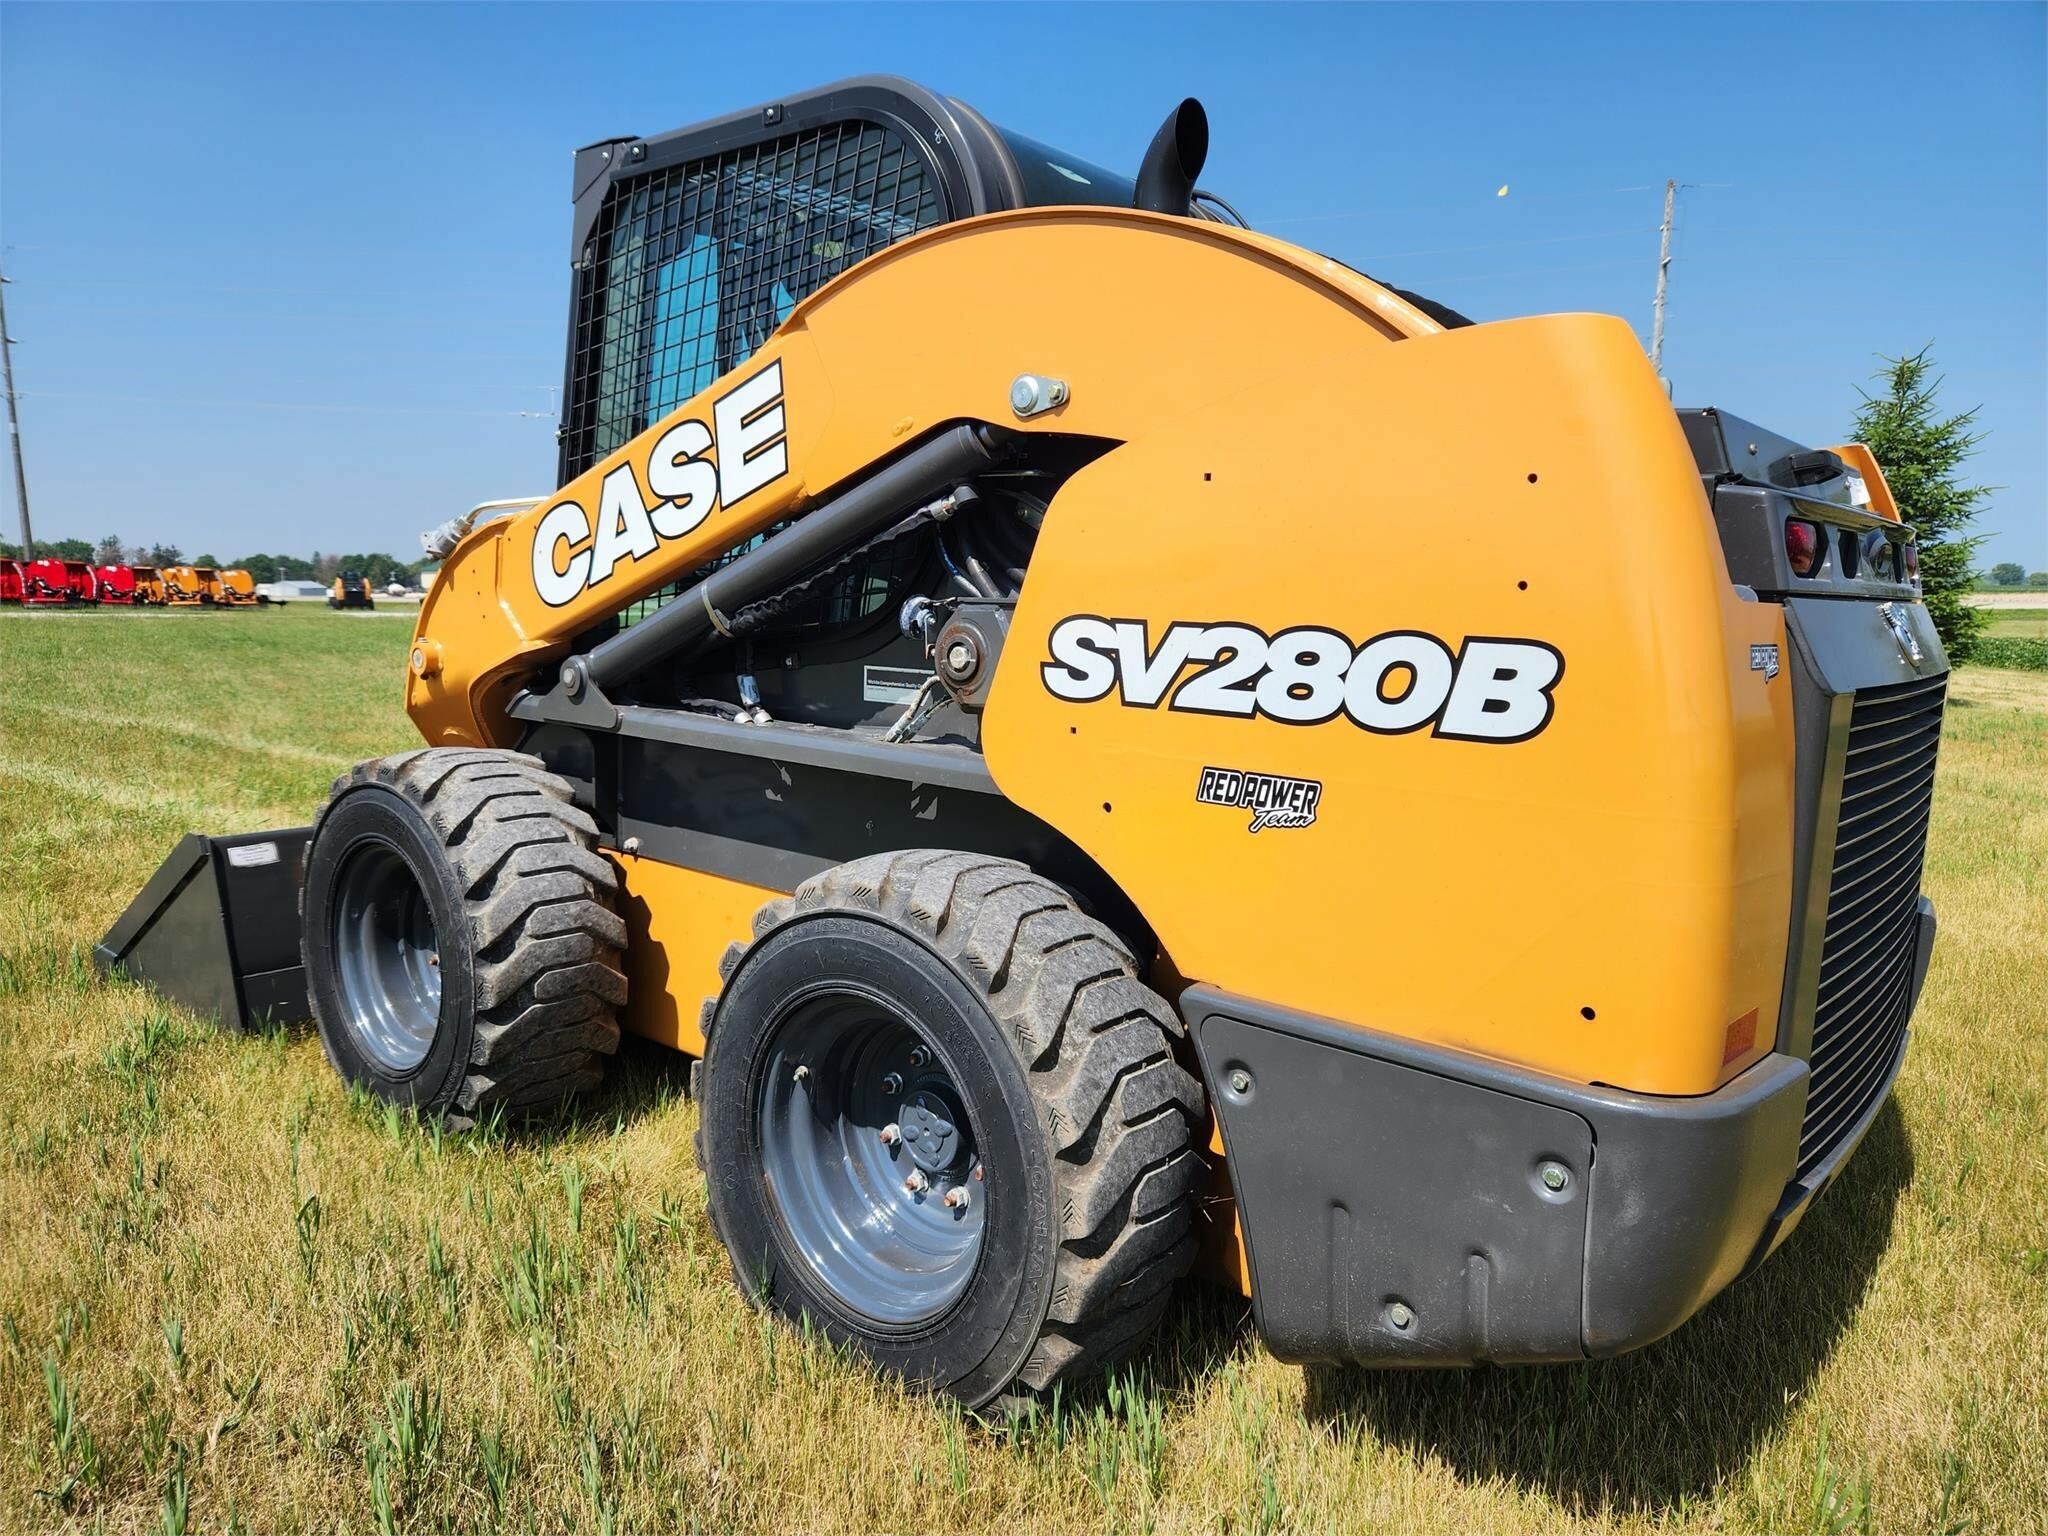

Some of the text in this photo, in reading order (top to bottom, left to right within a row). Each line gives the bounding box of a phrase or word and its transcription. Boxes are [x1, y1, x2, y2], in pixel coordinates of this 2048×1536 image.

[532, 358, 789, 608] CASE
[1040, 614, 1566, 744] SV280B
[1198, 769, 1320, 816] RED POWER
[1251, 807, 1313, 830] Team
